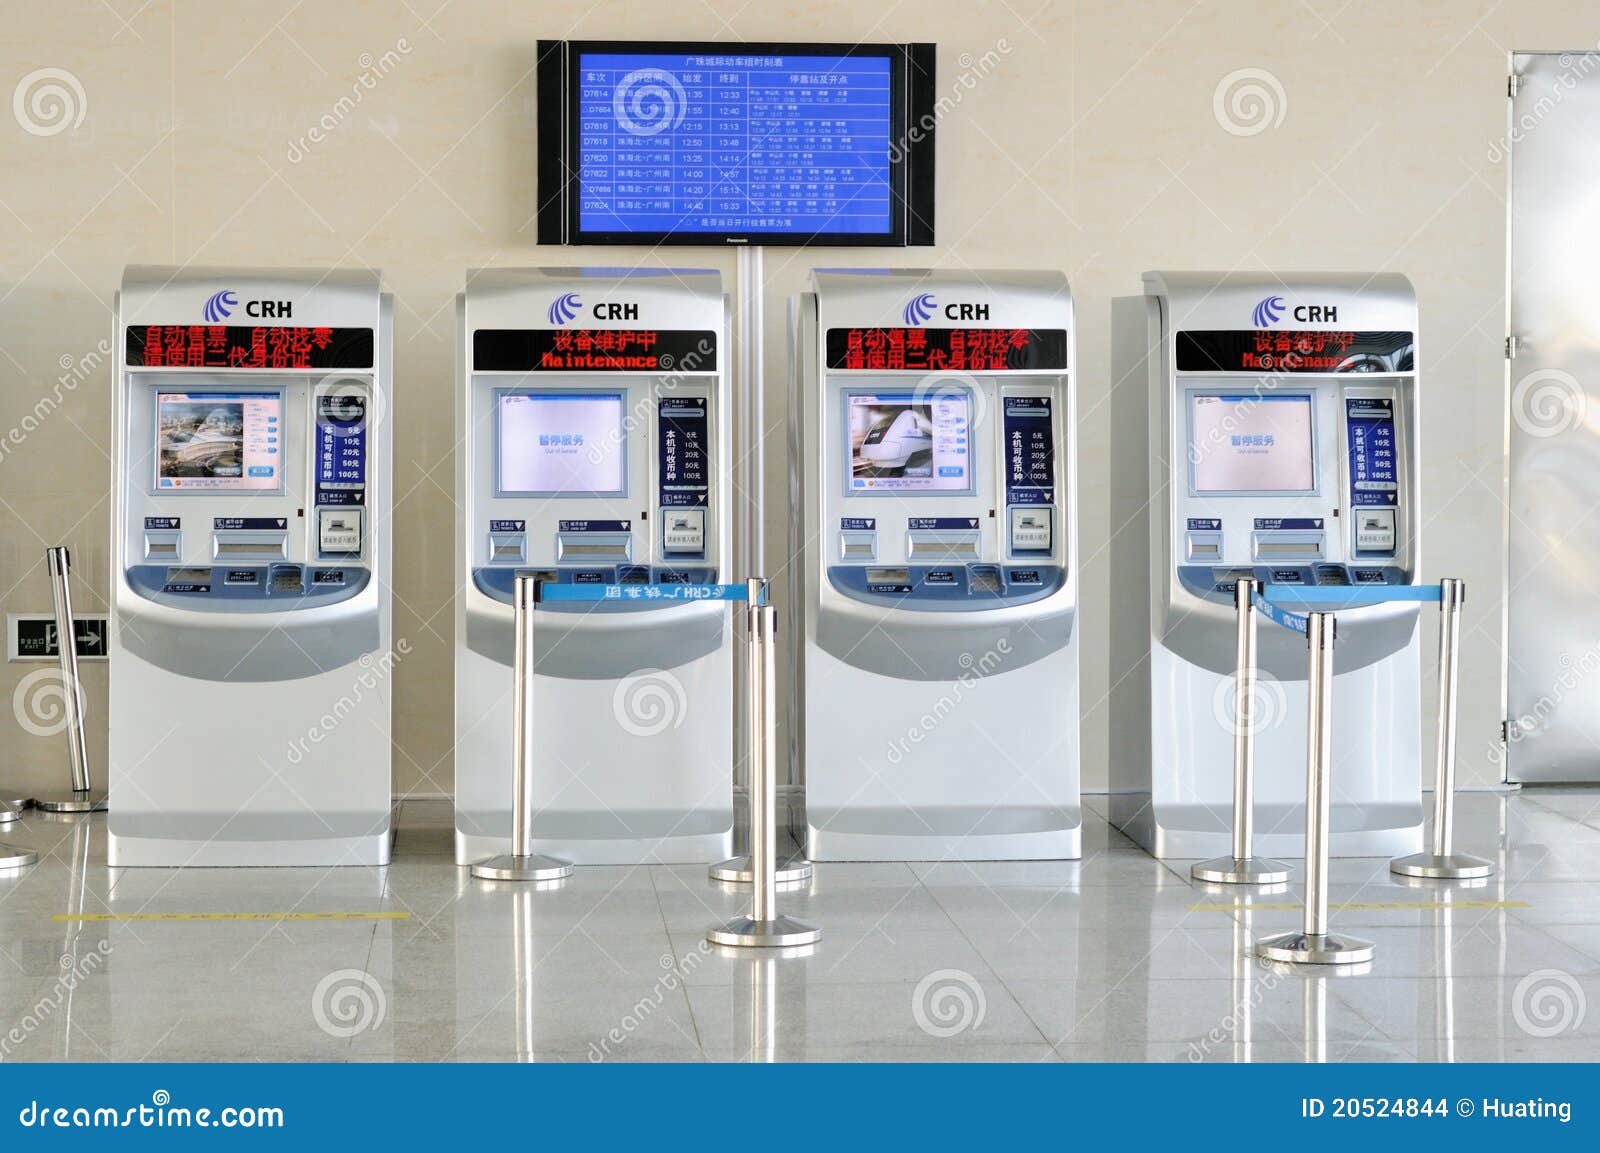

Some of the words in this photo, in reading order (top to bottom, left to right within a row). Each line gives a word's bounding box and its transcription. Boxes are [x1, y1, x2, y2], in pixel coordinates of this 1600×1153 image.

[587, 73, 606, 82] 车次
[246, 300, 292, 318] CRH
[593, 303, 639, 320] CRH
[945, 303, 989, 320] CRH
[1294, 306, 1338, 323] CRH
[553, 329, 657, 351] 设备维护中
[1253, 330, 1355, 352] 设备维护中
[541, 353, 657, 368] Maintenance
[539, 434, 584, 446] 暂停服务
[1231, 435, 1275, 447] 暂停服务
[323, 426, 334, 479] 本机可收币种
[666, 429, 677, 480] 本机可收币种
[1012, 431, 1023, 480] 本机可收币种
[1355, 428, 1366, 480] 本机可收币种
[684, 585, 711, 598] CRH
